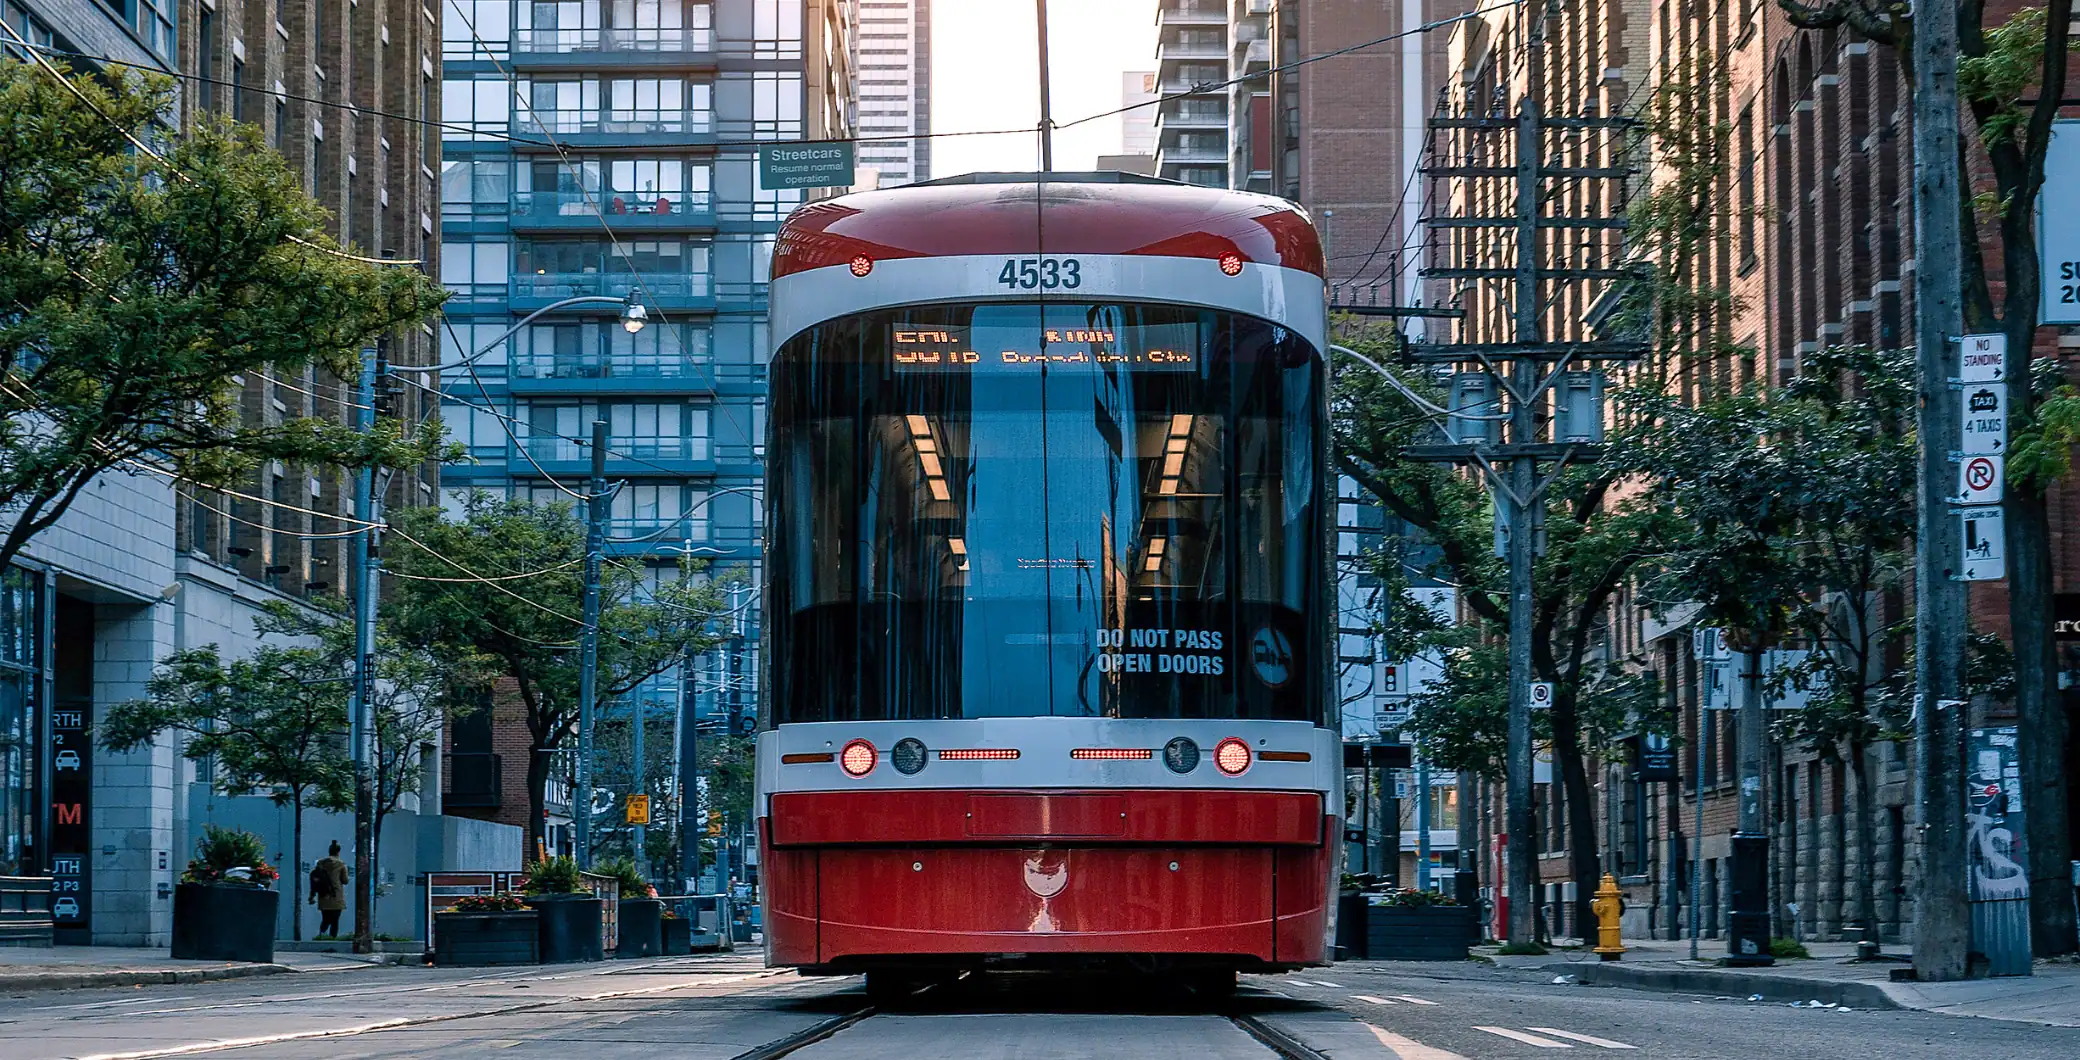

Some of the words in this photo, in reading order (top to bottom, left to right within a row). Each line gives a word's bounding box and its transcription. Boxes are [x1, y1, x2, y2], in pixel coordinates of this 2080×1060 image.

[771, 149, 842, 161] Streetcars
[770, 164, 809, 173] Resume
[811, 162, 844, 172] normal
[785, 174, 830, 185] operation
[998, 258, 1081, 289] 4533
[1976, 339, 1990, 351] NO
[1964, 354, 2002, 367] STANDING
[1973, 396, 1994, 407] TAXI
[1965, 420, 1974, 433] 4
[1976, 419, 2002, 433] TAXIS
[1096, 629, 1124, 649] DO
[1131, 629, 1170, 649] NOT
[1174, 629, 1224, 650] PASS
[1097, 653, 1152, 673] OPEN
[1158, 654, 1224, 675] DOORS
[63, 881, 80, 891] P3
